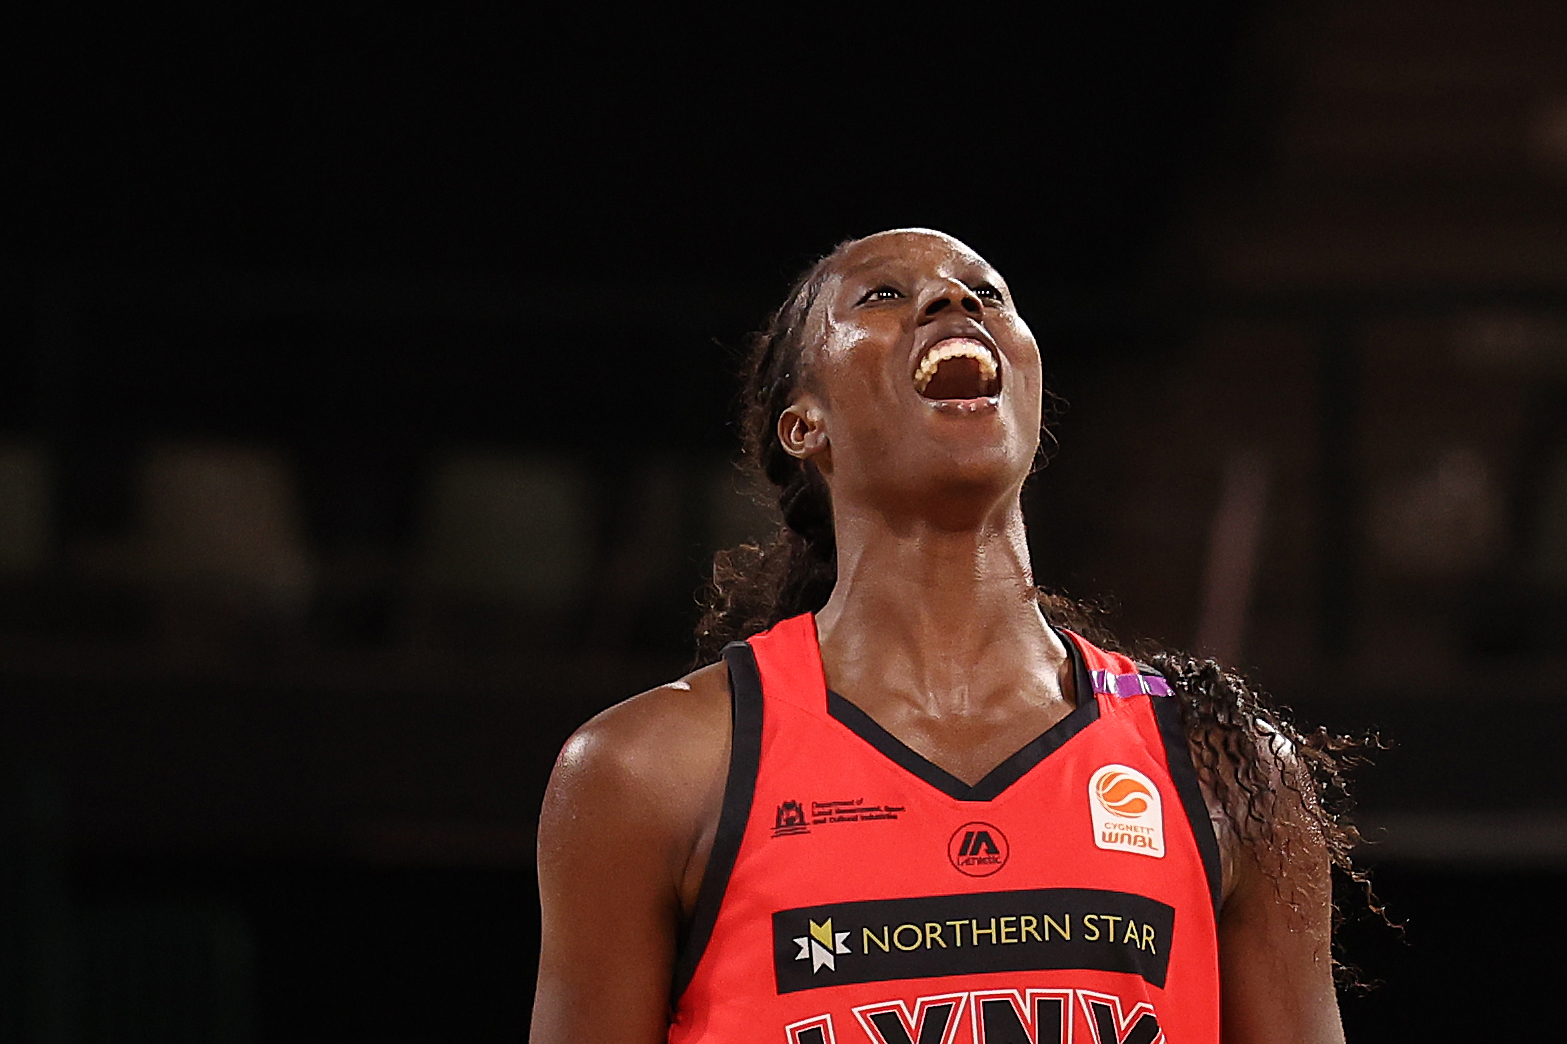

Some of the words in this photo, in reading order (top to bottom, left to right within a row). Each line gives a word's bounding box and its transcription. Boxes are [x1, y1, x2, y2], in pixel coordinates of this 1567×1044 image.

[1101, 831, 1159, 851] WNBL
[862, 914, 1072, 955] NORTHERN
[1083, 914, 1157, 956] STAR
